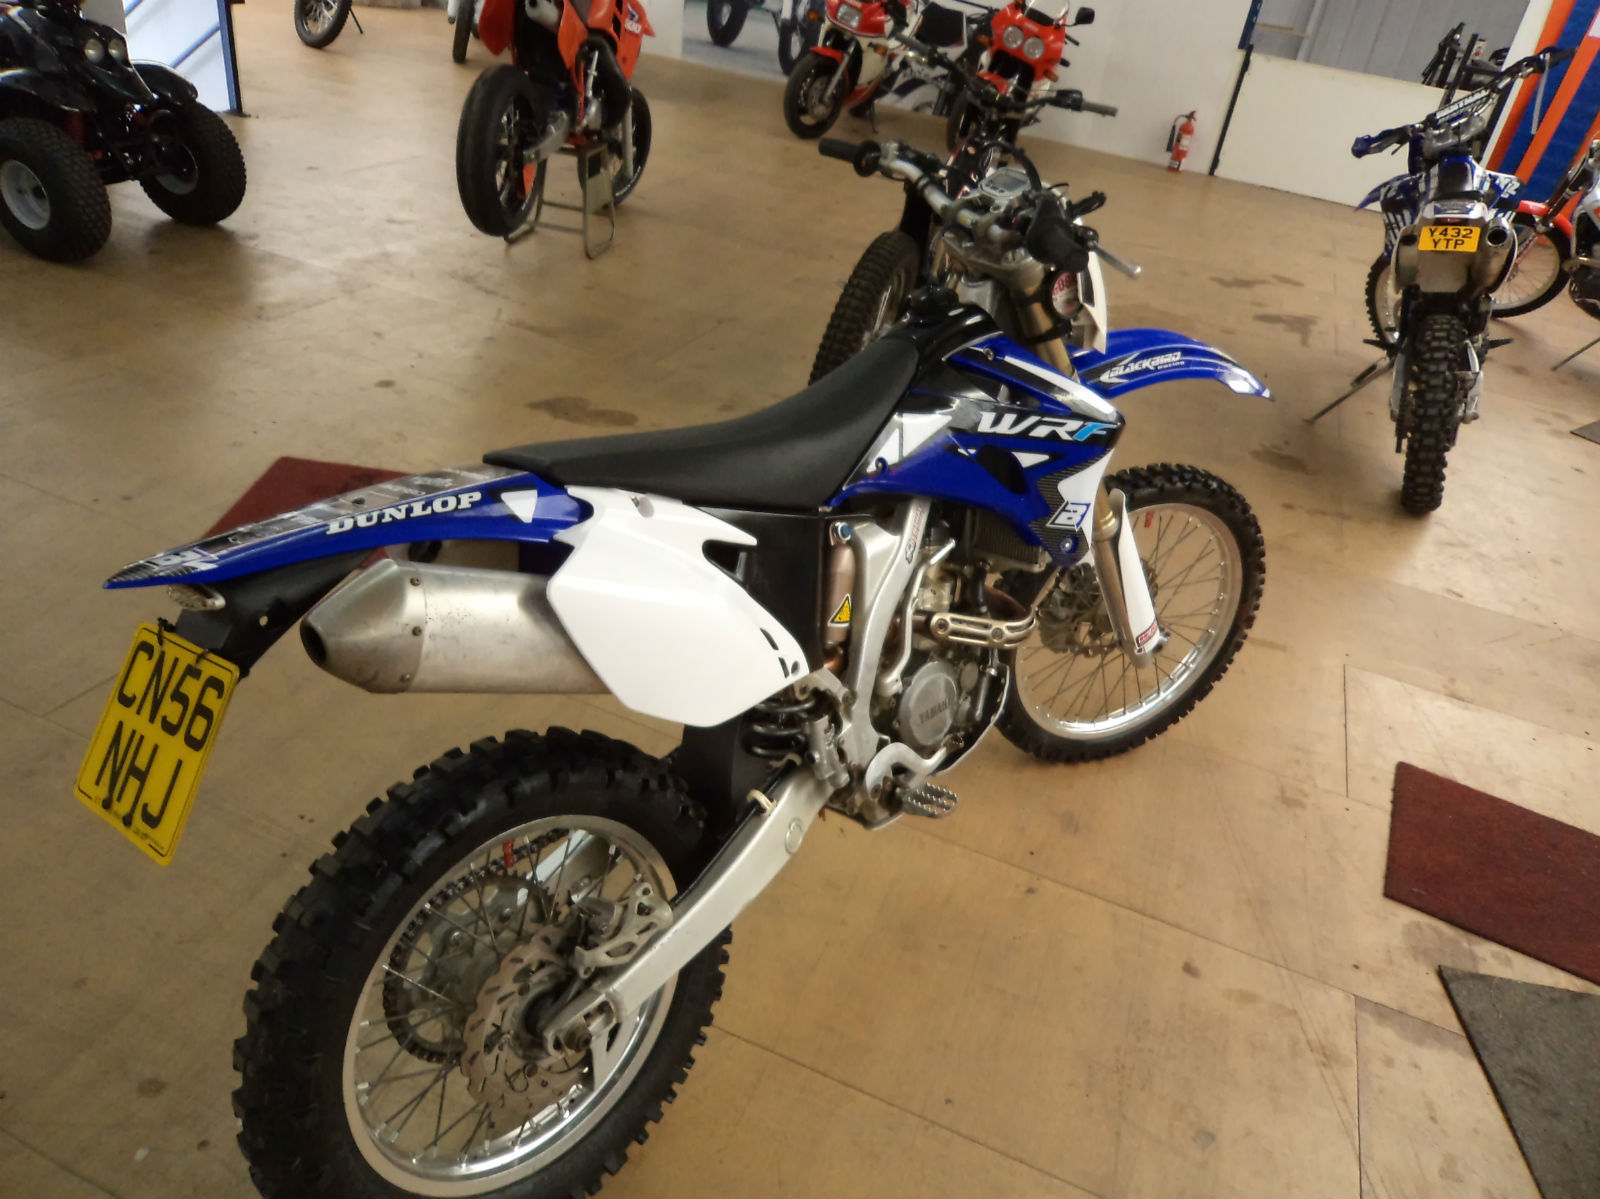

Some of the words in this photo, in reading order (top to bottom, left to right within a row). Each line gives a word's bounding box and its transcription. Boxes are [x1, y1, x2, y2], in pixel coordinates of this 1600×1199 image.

[1429, 227, 1473, 239] Y432
[1432, 238, 1465, 249] YTP
[977, 411, 1118, 442] WRF
[326, 491, 482, 535] DUNLOP
[117, 640, 225, 752] CN56
[95, 720, 182, 829] NHJ
